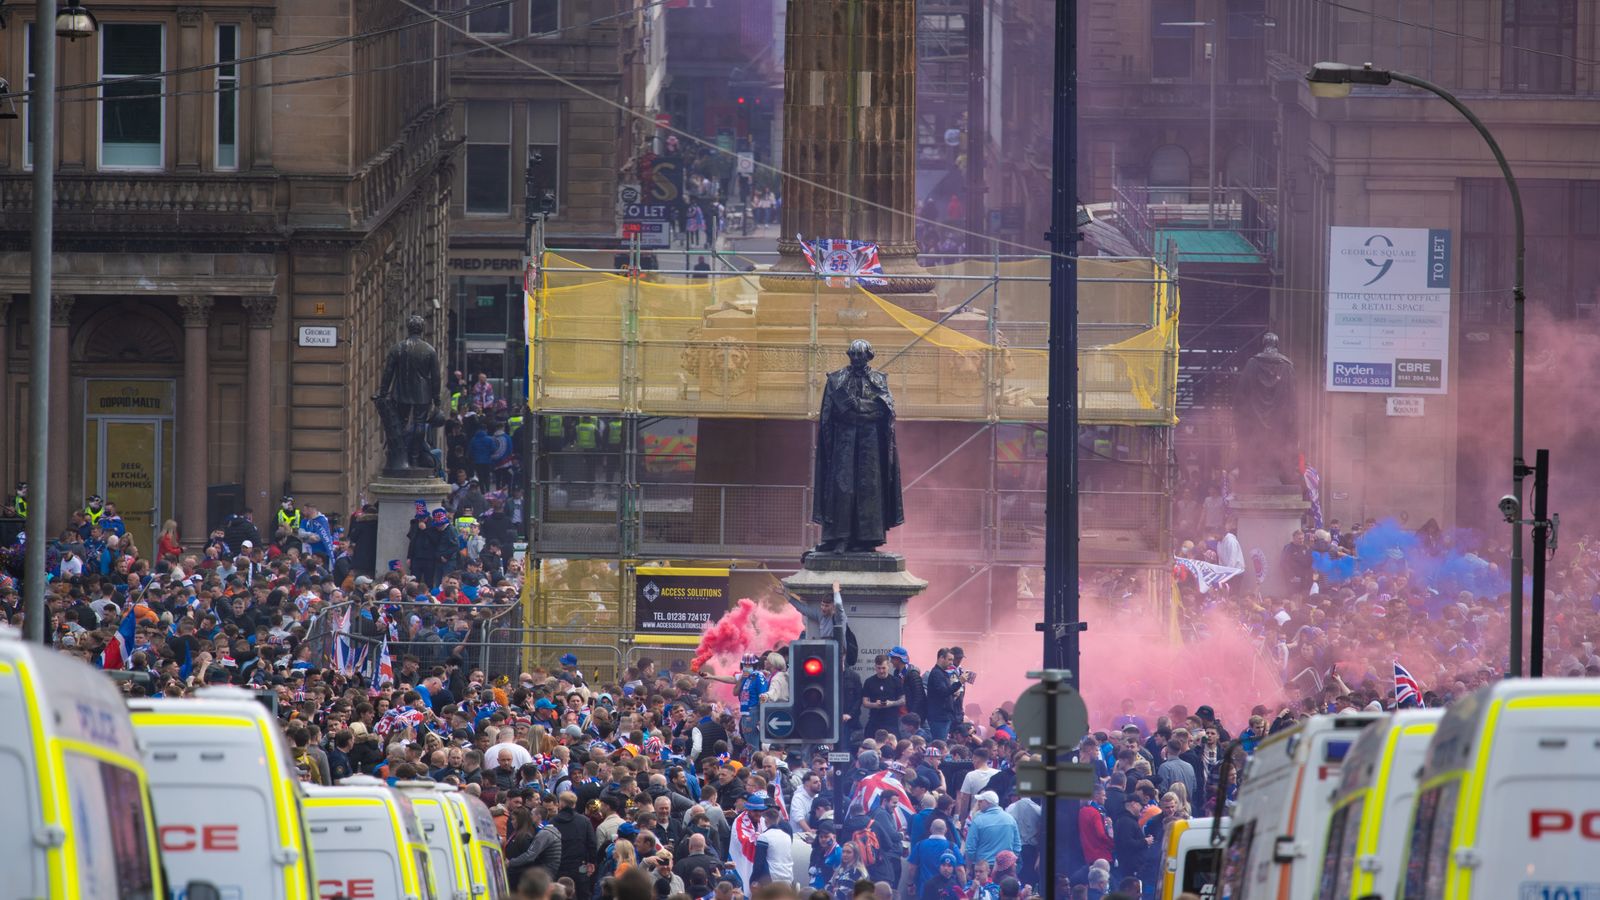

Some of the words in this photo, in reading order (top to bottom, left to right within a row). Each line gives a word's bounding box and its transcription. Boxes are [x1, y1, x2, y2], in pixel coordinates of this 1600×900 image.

[644, 205, 665, 217] LET
[1341, 248, 1379, 256] GEORGE
[1380, 249, 1417, 258] SQUARE
[1433, 236, 1445, 260] LET
[482, 258, 523, 270] PERR
[830, 259, 849, 271] 55
[1432, 262, 1444, 281] TO
[1336, 292, 1361, 300] HIGH
[1363, 292, 1405, 302] QUALITY
[1407, 294, 1441, 302] OFFICE
[1361, 303, 1395, 311] RETAIL
[1397, 304, 1425, 312] SPACE
[304, 328, 332, 336] GEORGE
[304, 336, 330, 344] SQUARE
[1335, 364, 1374, 377] Ryden
[1397, 362, 1432, 373] CBRE
[1334, 376, 1351, 385] 0141
[1352, 377, 1368, 385] 204
[1370, 378, 1390, 386] 3838
[108, 481, 152, 489] HAPPINESS
[661, 587, 686, 597] ACCESS
[687, 588, 722, 598] SOLUTIONS
[653, 612, 666, 621] TEL.
[666, 612, 687, 621] 01236
[688, 613, 711, 622] 724137
